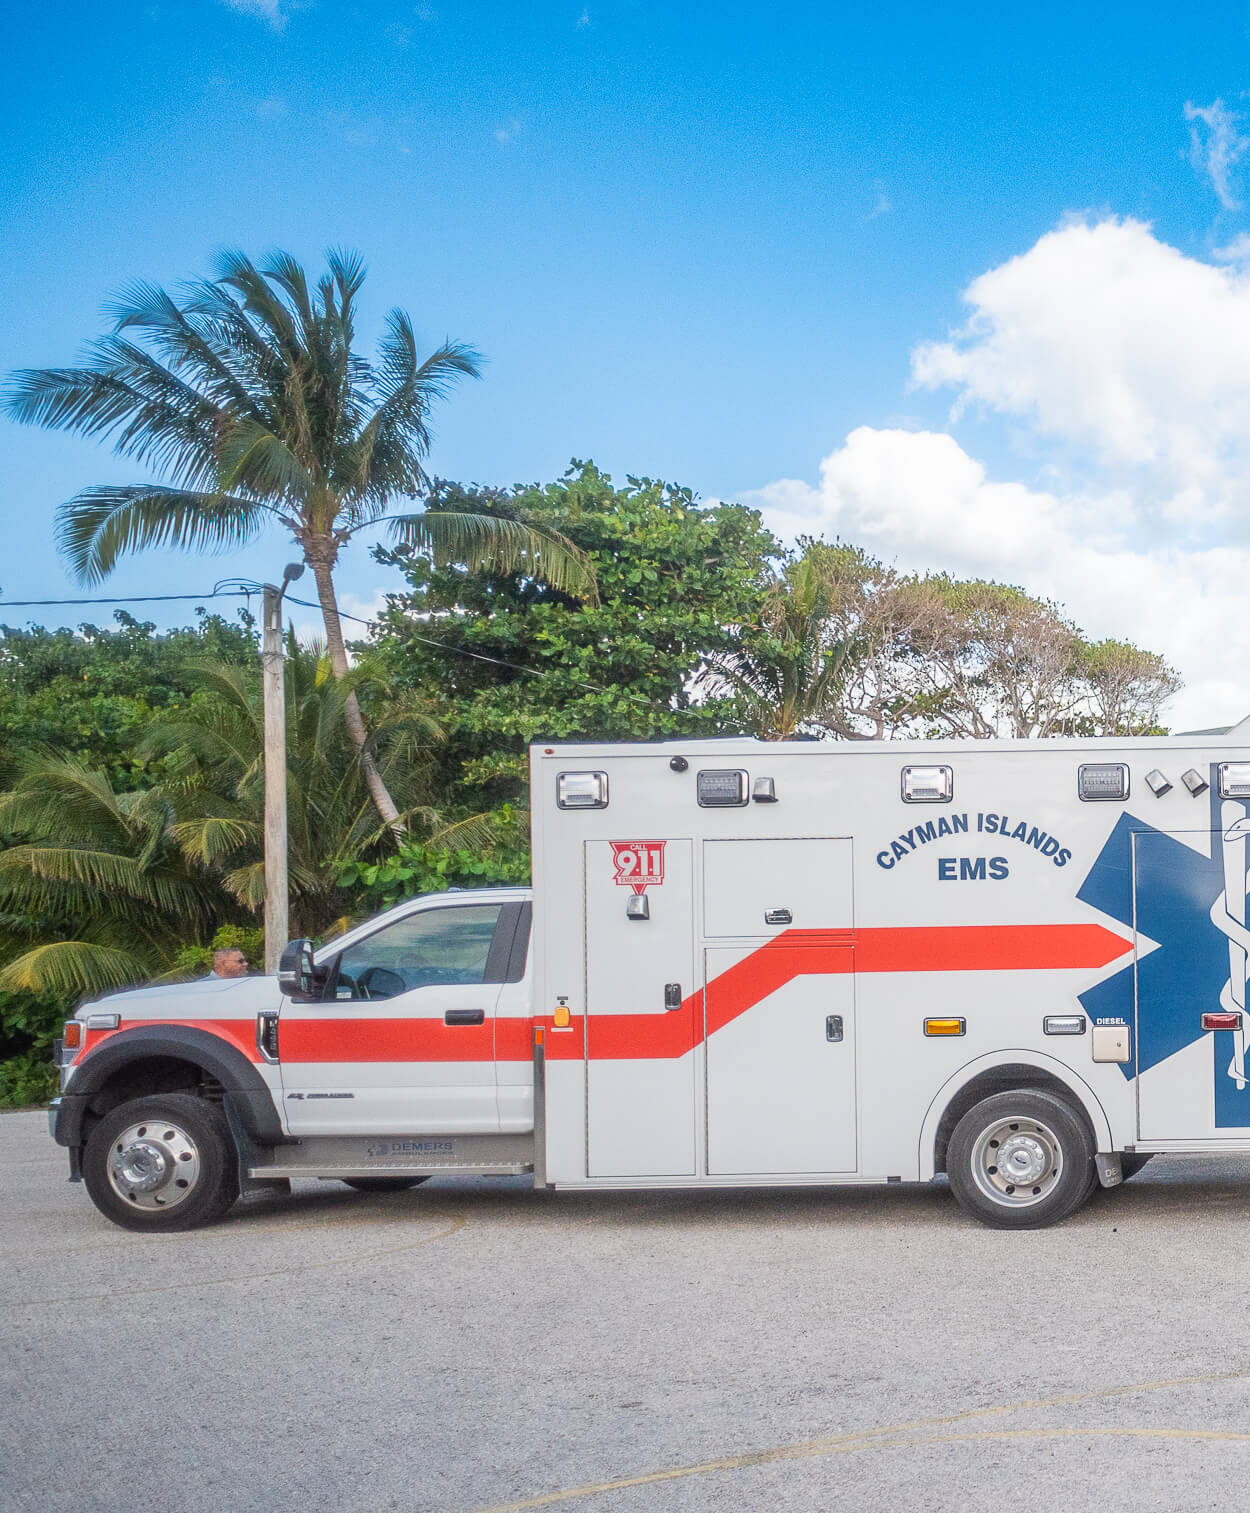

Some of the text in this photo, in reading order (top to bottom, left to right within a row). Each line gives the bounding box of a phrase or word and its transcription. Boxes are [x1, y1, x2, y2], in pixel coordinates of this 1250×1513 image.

[876, 813, 1072, 870] CAYMAN ISLANDS
[938, 857, 1010, 881] EMS
[1096, 1017, 1126, 1025] DIESEL
[391, 1142, 453, 1151] DEMERS
